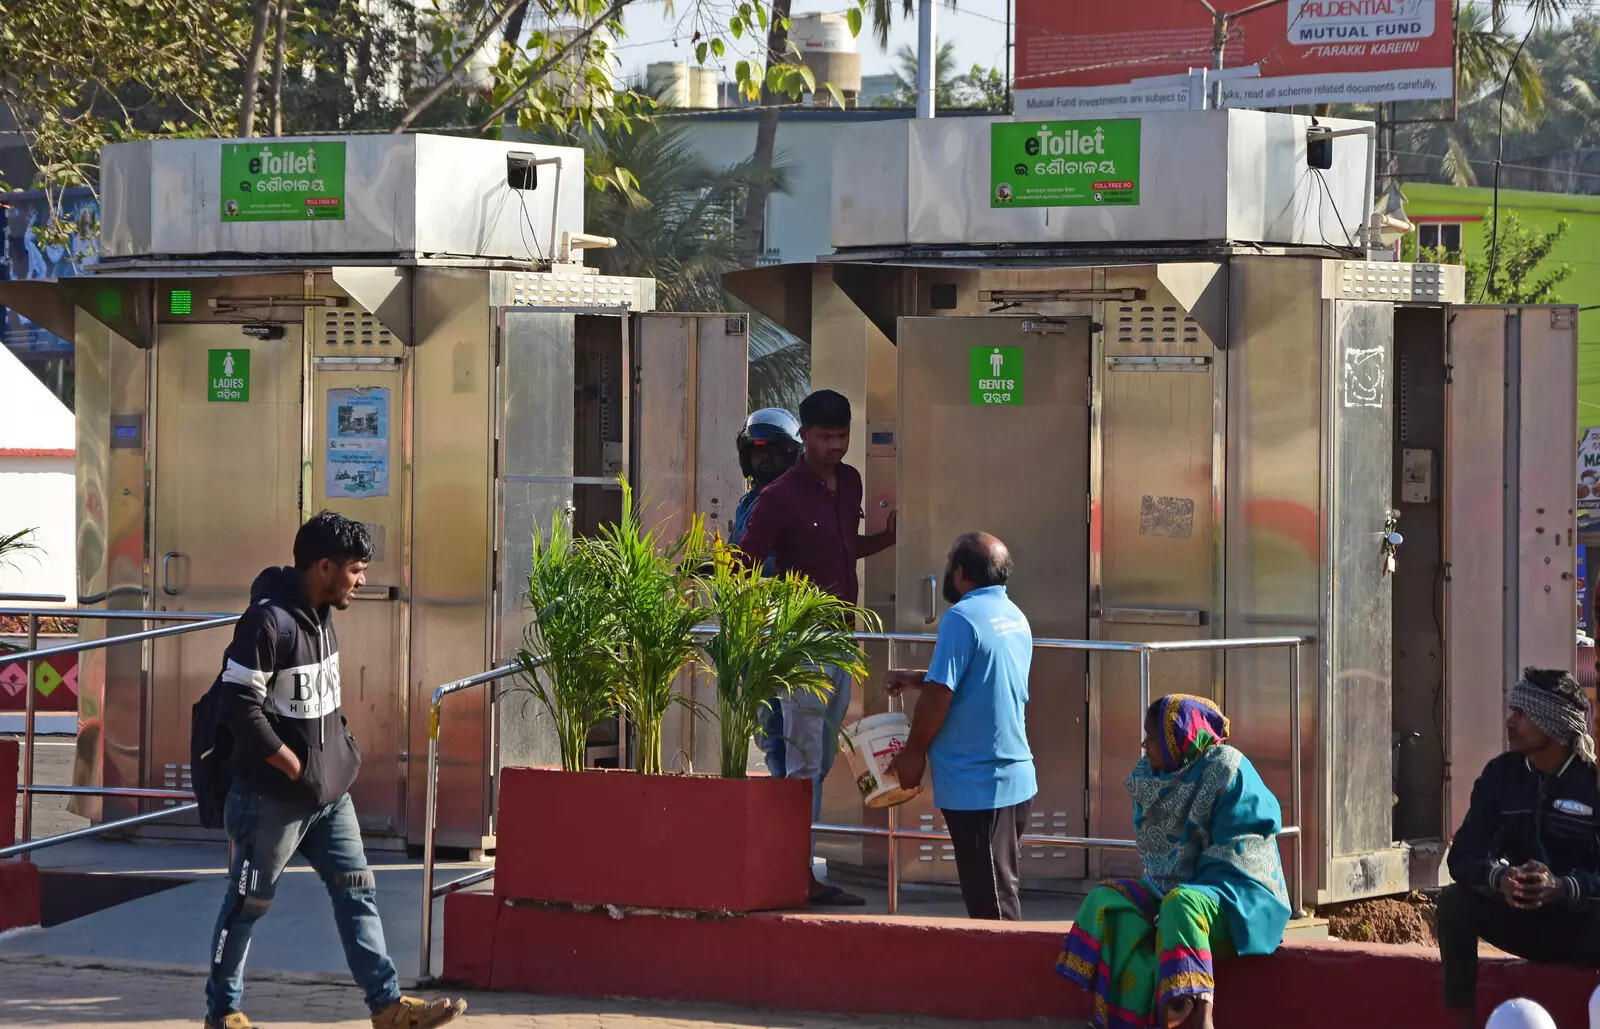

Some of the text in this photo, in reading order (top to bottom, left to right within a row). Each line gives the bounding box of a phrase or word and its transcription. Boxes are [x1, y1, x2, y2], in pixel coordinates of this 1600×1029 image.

[1300, 0, 1396, 18] PRUDENTIAL
[1300, 22, 1421, 40] MUTUAL FUND
[1315, 41, 1419, 57] TARAKKI KAREIN!
[1027, 98, 1055, 109] Mutual
[1056, 97, 1076, 107] Fund
[1078, 96, 1128, 107] investments
[1130, 95, 1143, 103] are
[1145, 92, 1175, 104] subject
[1177, 93, 1186, 102] to
[1244, 89, 1263, 99] read
[1266, 88, 1276, 97] all
[1279, 86, 1312, 96] scheme
[1314, 84, 1344, 94] related
[1346, 82, 1395, 93] documents
[1398, 78, 1438, 91] carefully,
[1024, 125, 1105, 156] eToilet
[249, 146, 316, 174] eToilet
[213, 378, 244, 389] LADIES
[978, 379, 1015, 390] GENTS
